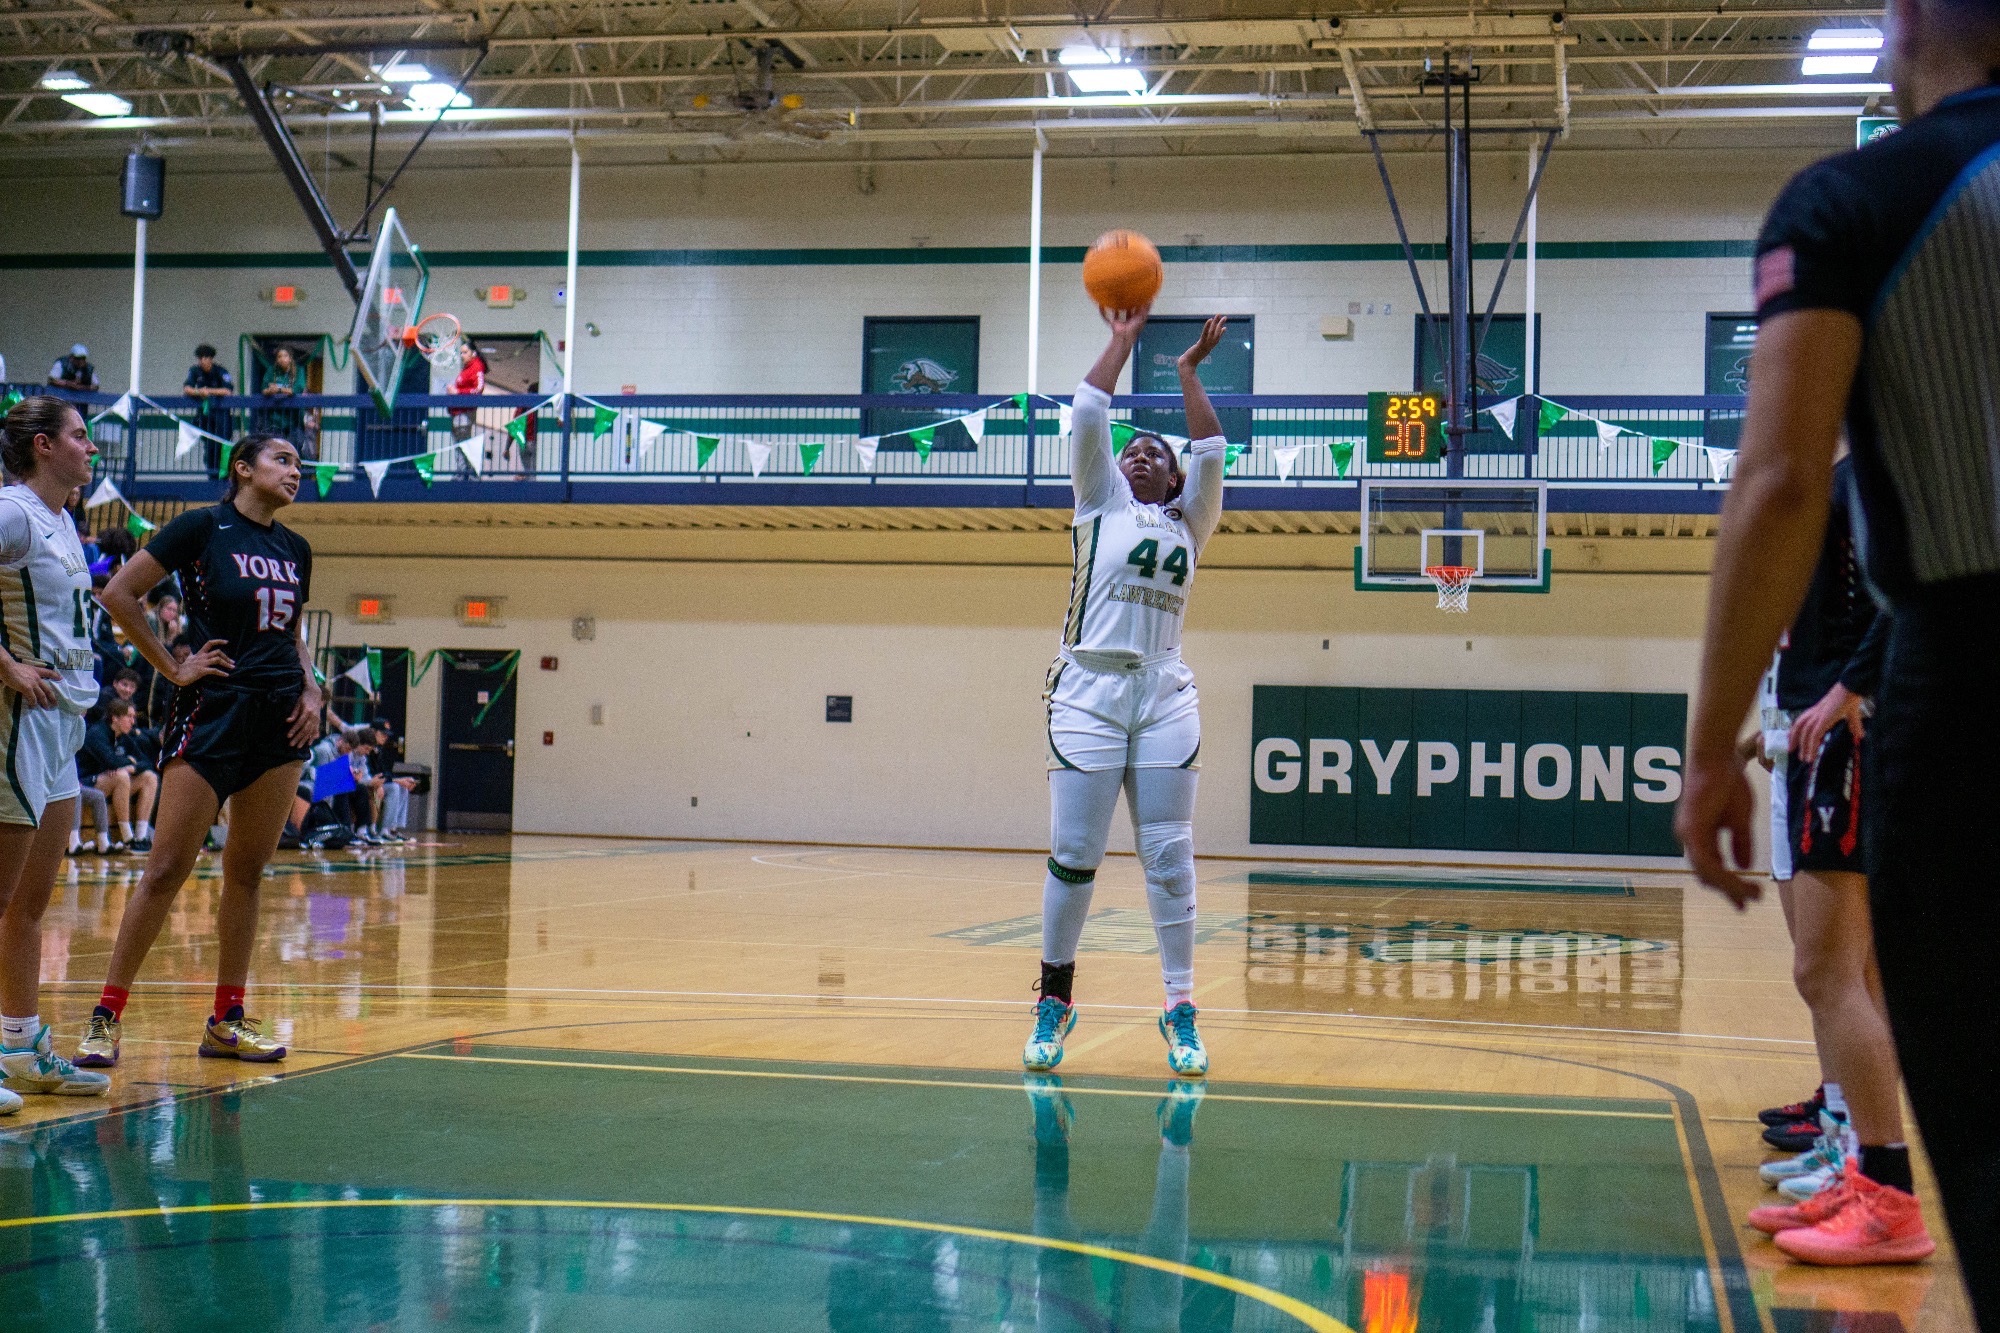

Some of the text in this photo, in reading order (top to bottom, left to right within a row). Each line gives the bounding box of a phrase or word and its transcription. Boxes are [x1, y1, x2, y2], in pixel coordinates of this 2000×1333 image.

[1387, 397, 1436, 419] 2:59
[1385, 420, 1426, 456] 30
[231, 553, 300, 586] YORK
[1127, 537, 1189, 587] 44
[254, 586, 296, 633] 15
[1253, 738, 1683, 803] GRYPHONS
[1817, 806, 1835, 832] Y
